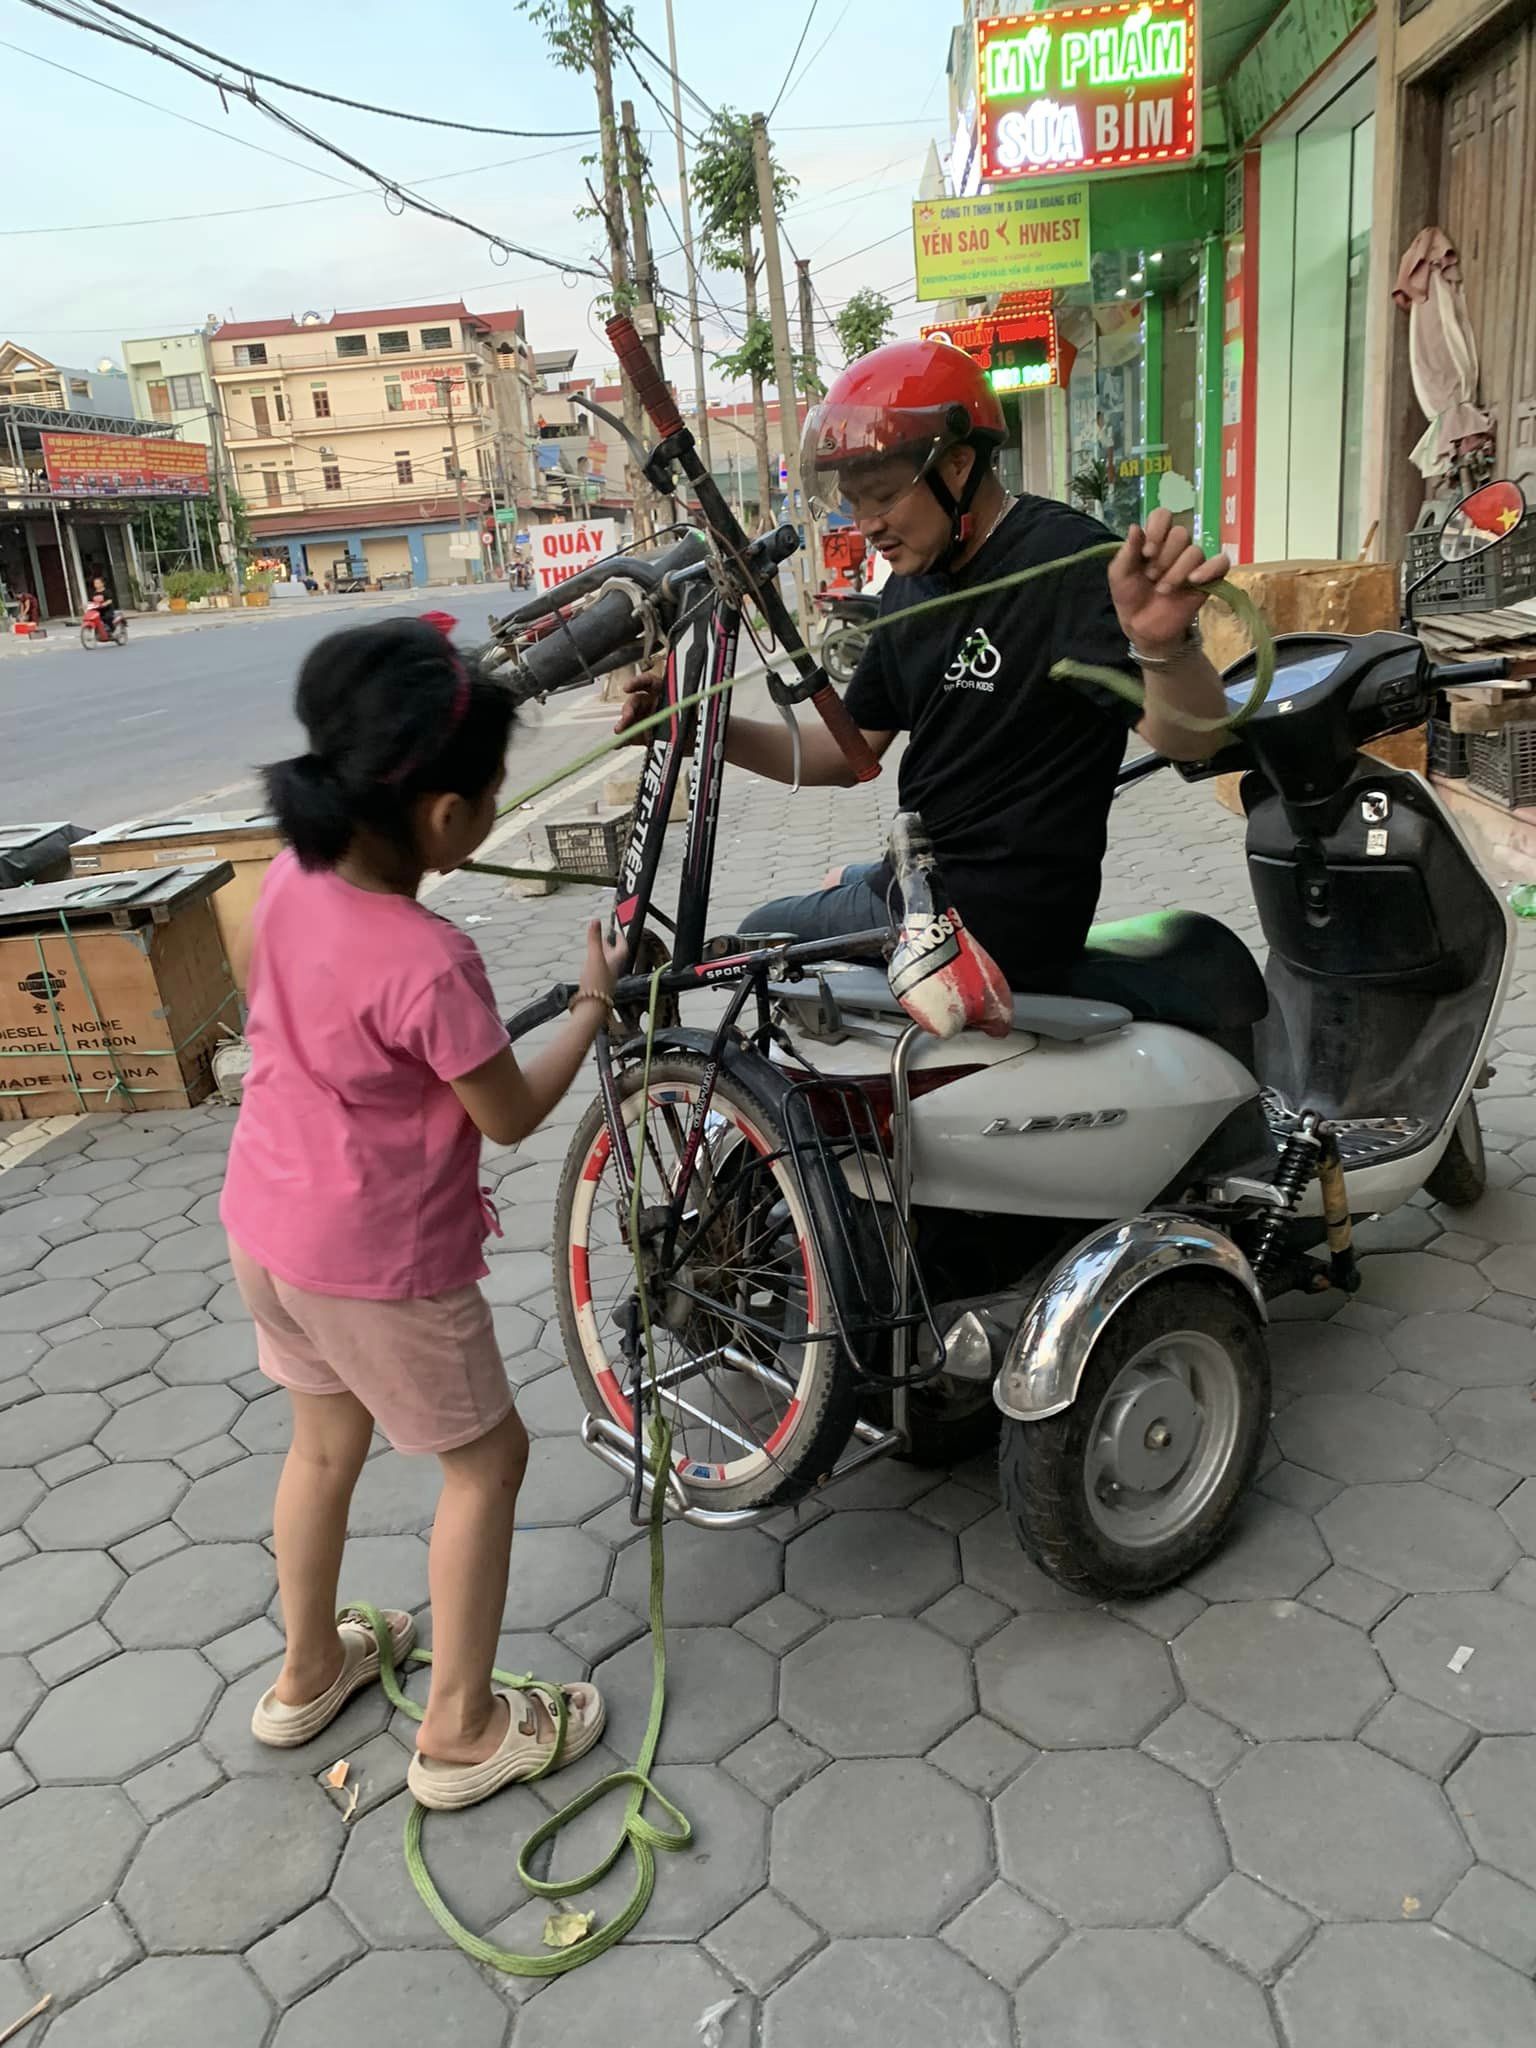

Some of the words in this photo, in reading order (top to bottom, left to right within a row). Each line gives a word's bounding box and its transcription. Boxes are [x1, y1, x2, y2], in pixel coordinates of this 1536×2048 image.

[1095, 86, 1174, 151] BỈM
[1019, 218, 1081, 246] HVNEST
[955, 680, 975, 689] FOR
[77, 1036, 136, 1049] R180N
[981, 1108, 1129, 1136] LEAD
